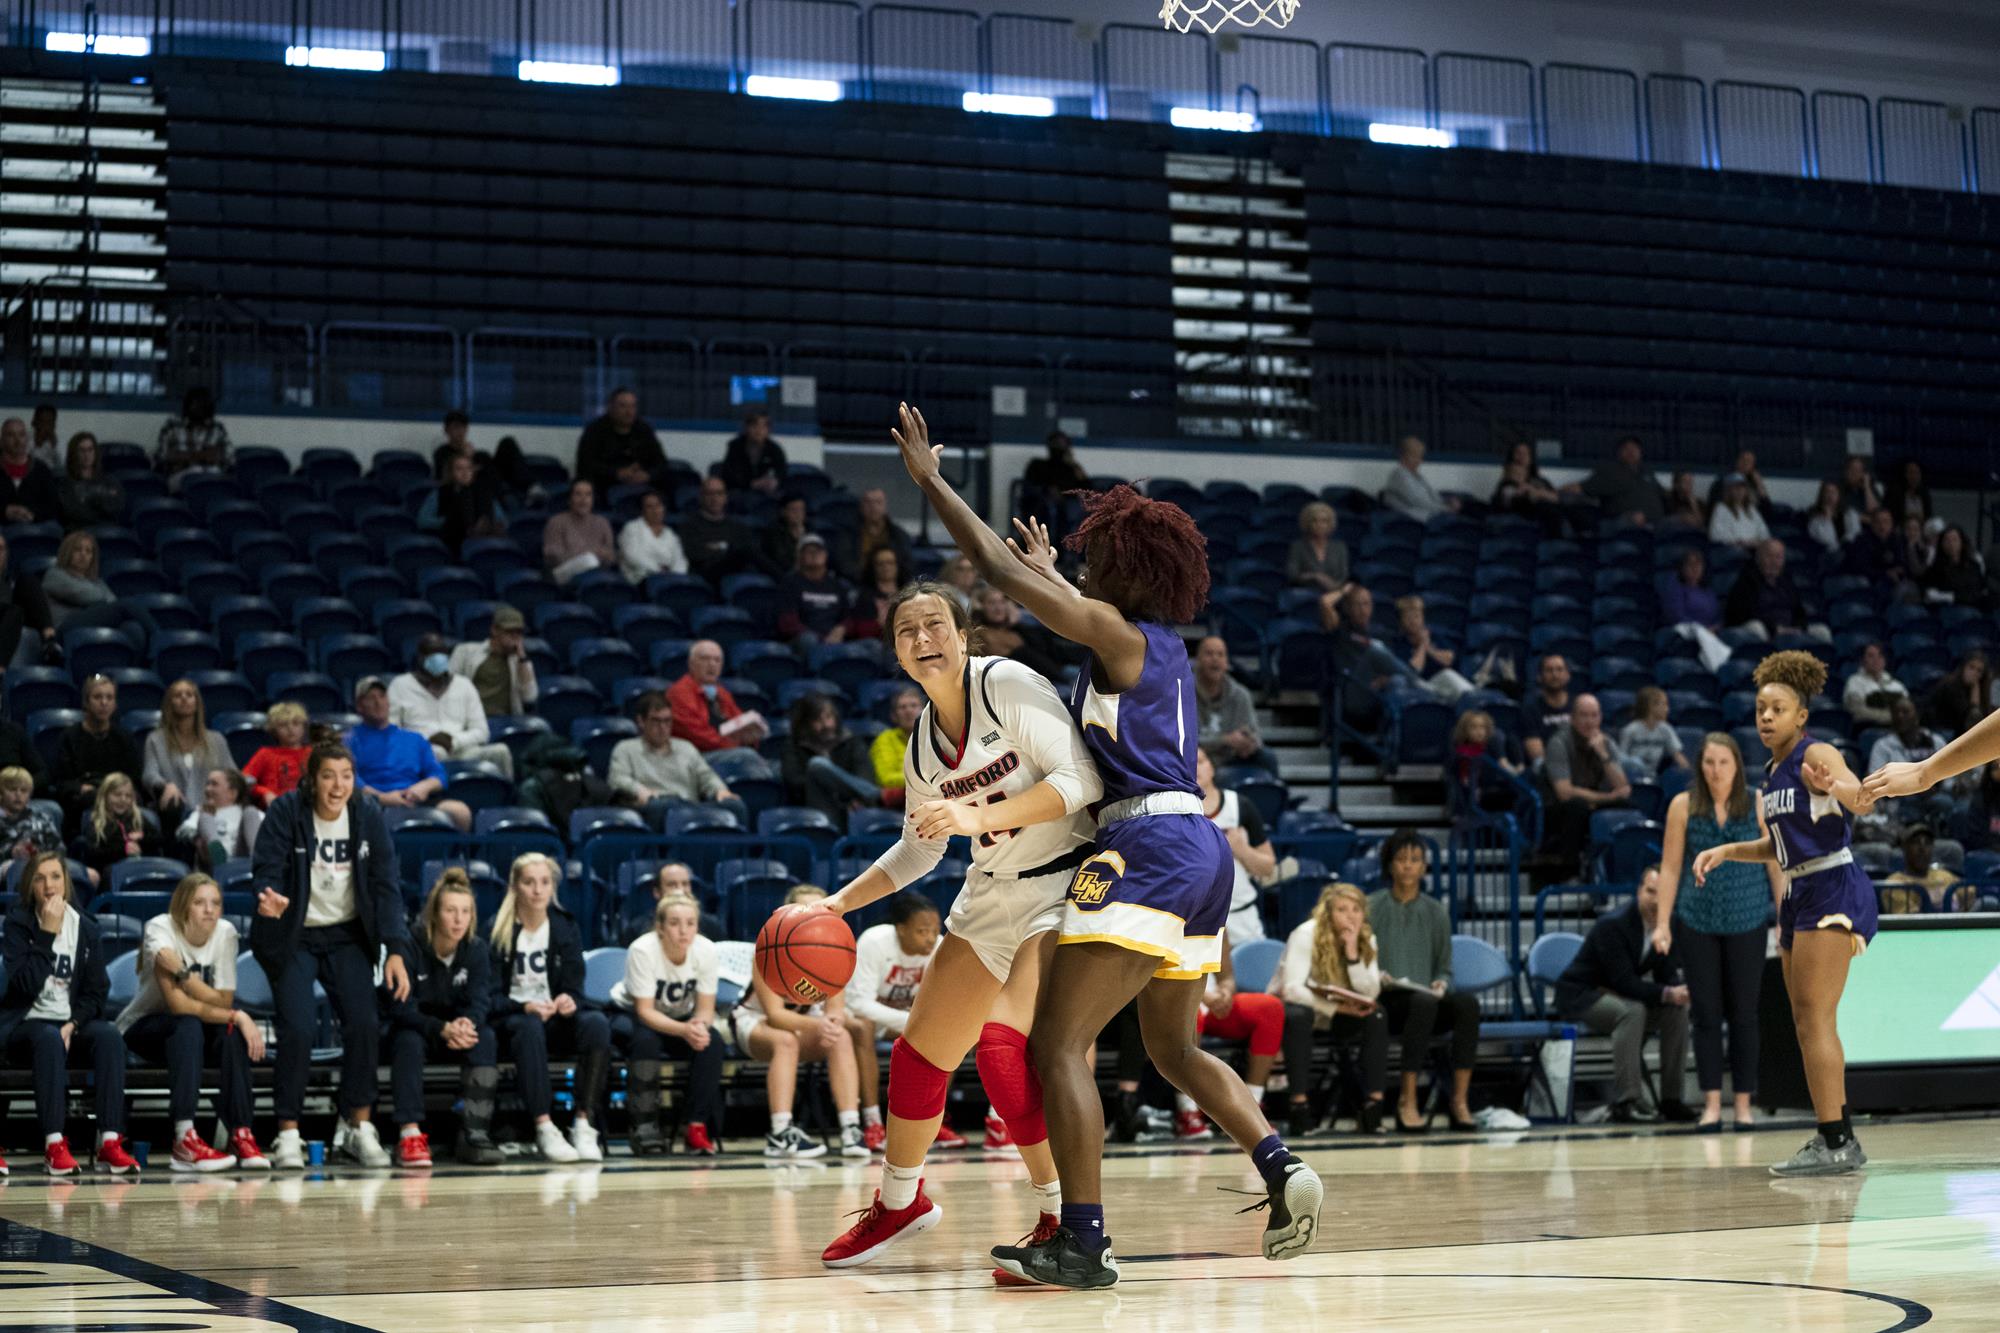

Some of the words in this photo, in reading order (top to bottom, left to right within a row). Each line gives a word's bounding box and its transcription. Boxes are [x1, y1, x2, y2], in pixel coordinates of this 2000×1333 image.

[940, 750, 1020, 799] SAMFORD
[1071, 871, 1112, 904] UM
[516, 950, 550, 975] TC
[794, 976, 829, 1002] Wil
